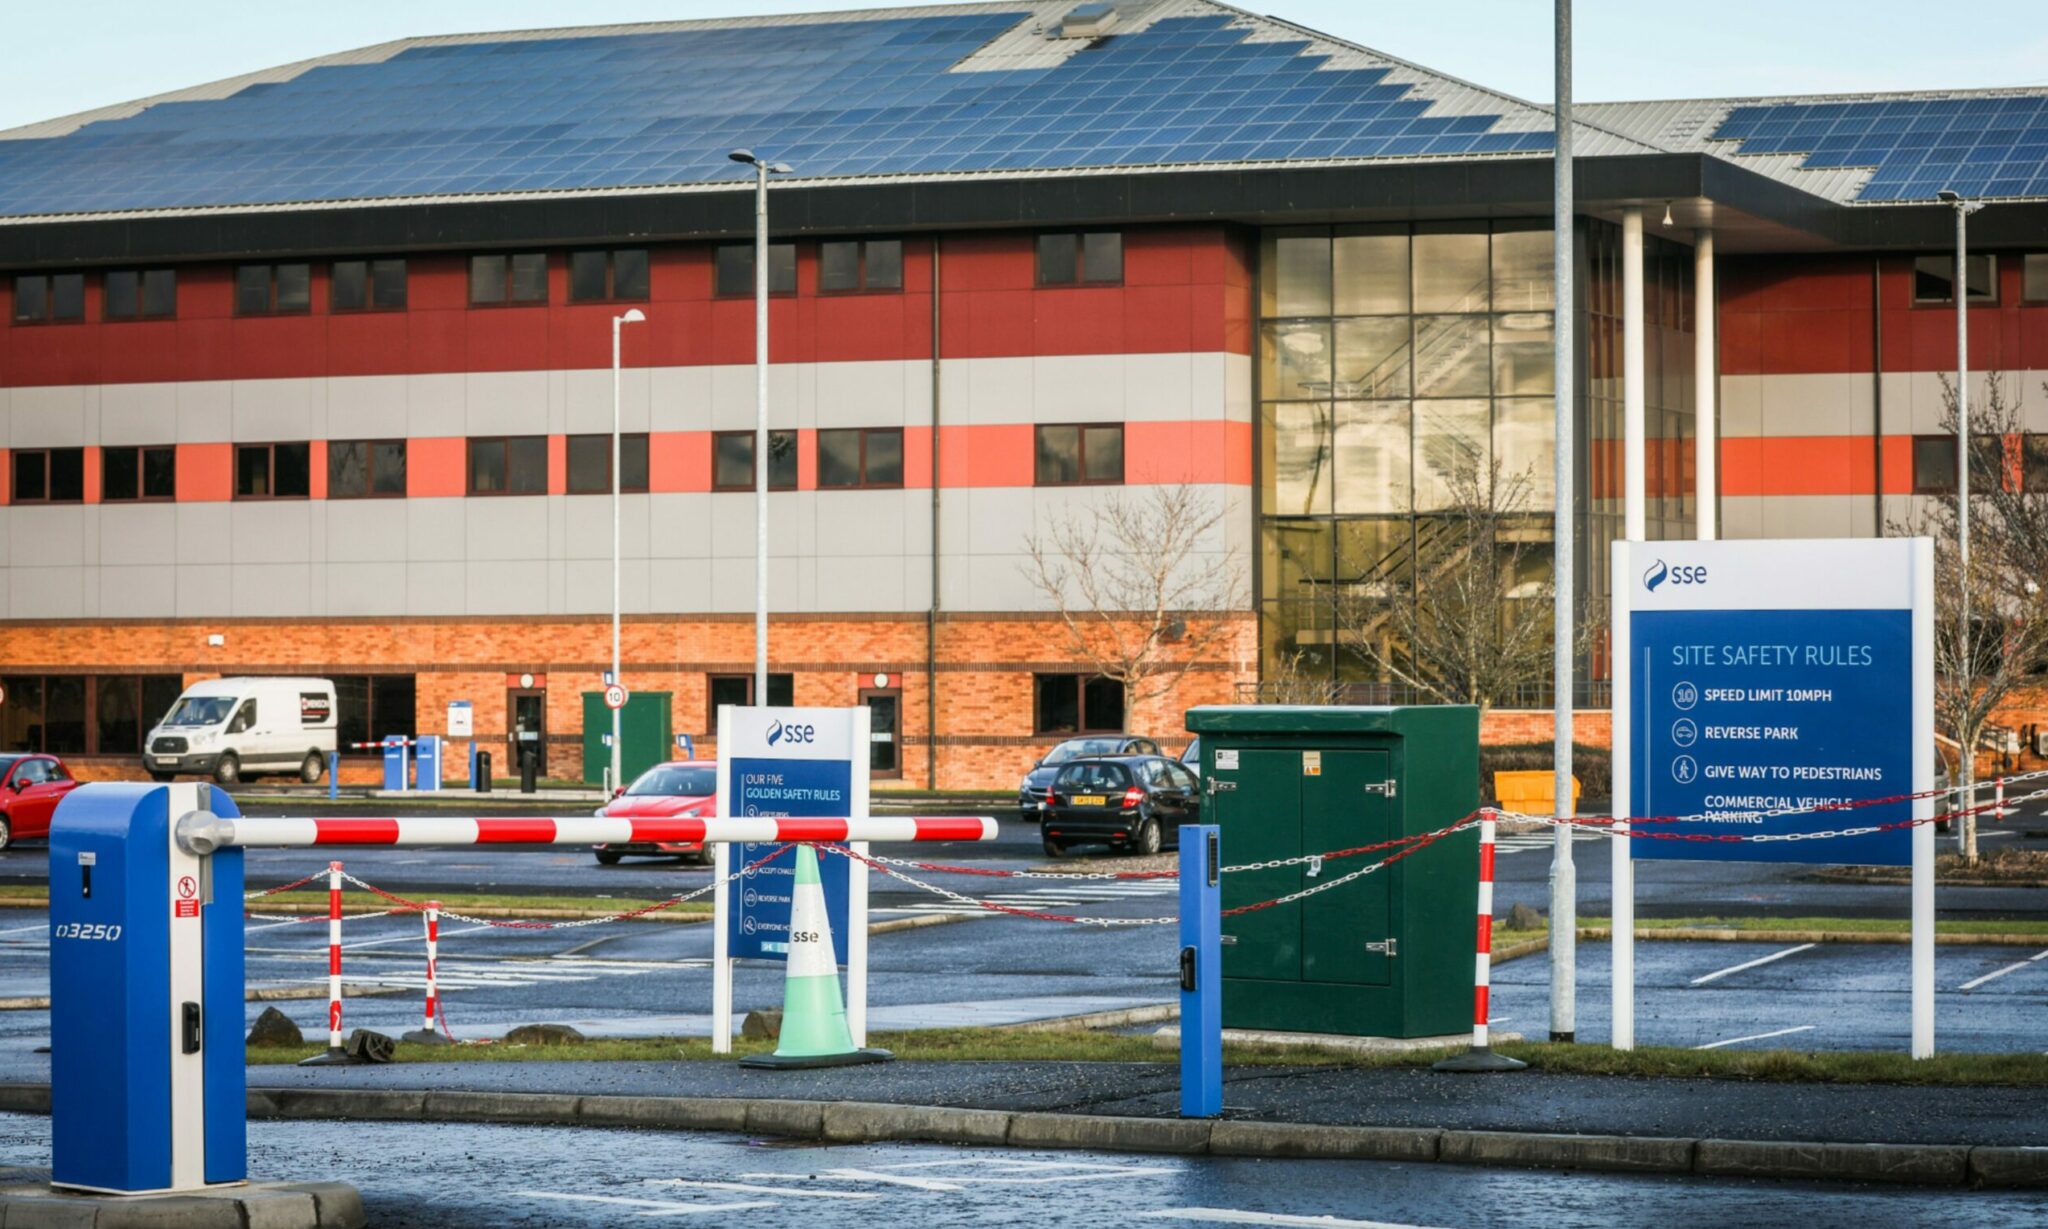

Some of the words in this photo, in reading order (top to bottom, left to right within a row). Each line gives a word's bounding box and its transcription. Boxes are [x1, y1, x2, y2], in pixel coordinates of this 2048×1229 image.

[1671, 565, 1707, 584] sse
[1672, 645, 1715, 666] SITE
[1722, 645, 1798, 666] SAFETY
[1805, 645, 1872, 666] RULES
[609, 693, 620, 702] 10
[1704, 689, 1745, 702] SPEED
[1748, 689, 1784, 702] LIMIT
[1786, 689, 1832, 702] 10MPH
[784, 724, 815, 743] sse
[1704, 726, 1761, 739] REVERSE
[1764, 727, 1799, 740] PARK
[746, 774, 765, 785] OUR
[767, 774, 784, 786] FIVE
[1704, 765, 1735, 778] GIVE
[1738, 766, 1768, 779] WAY
[1770, 766, 1790, 779] TO
[1793, 767, 1882, 781] PEDESTRIANS
[746, 788, 781, 799] GOLDEN
[783, 789, 813, 800] SAFETY
[814, 789, 840, 801] RULES
[1704, 795, 1793, 809] COMMERCIAL
[1796, 796, 1853, 811] VEHICLE
[1704, 810, 1763, 824] PARKING
[56, 922, 122, 942] 03250
[793, 931, 819, 943] sse
